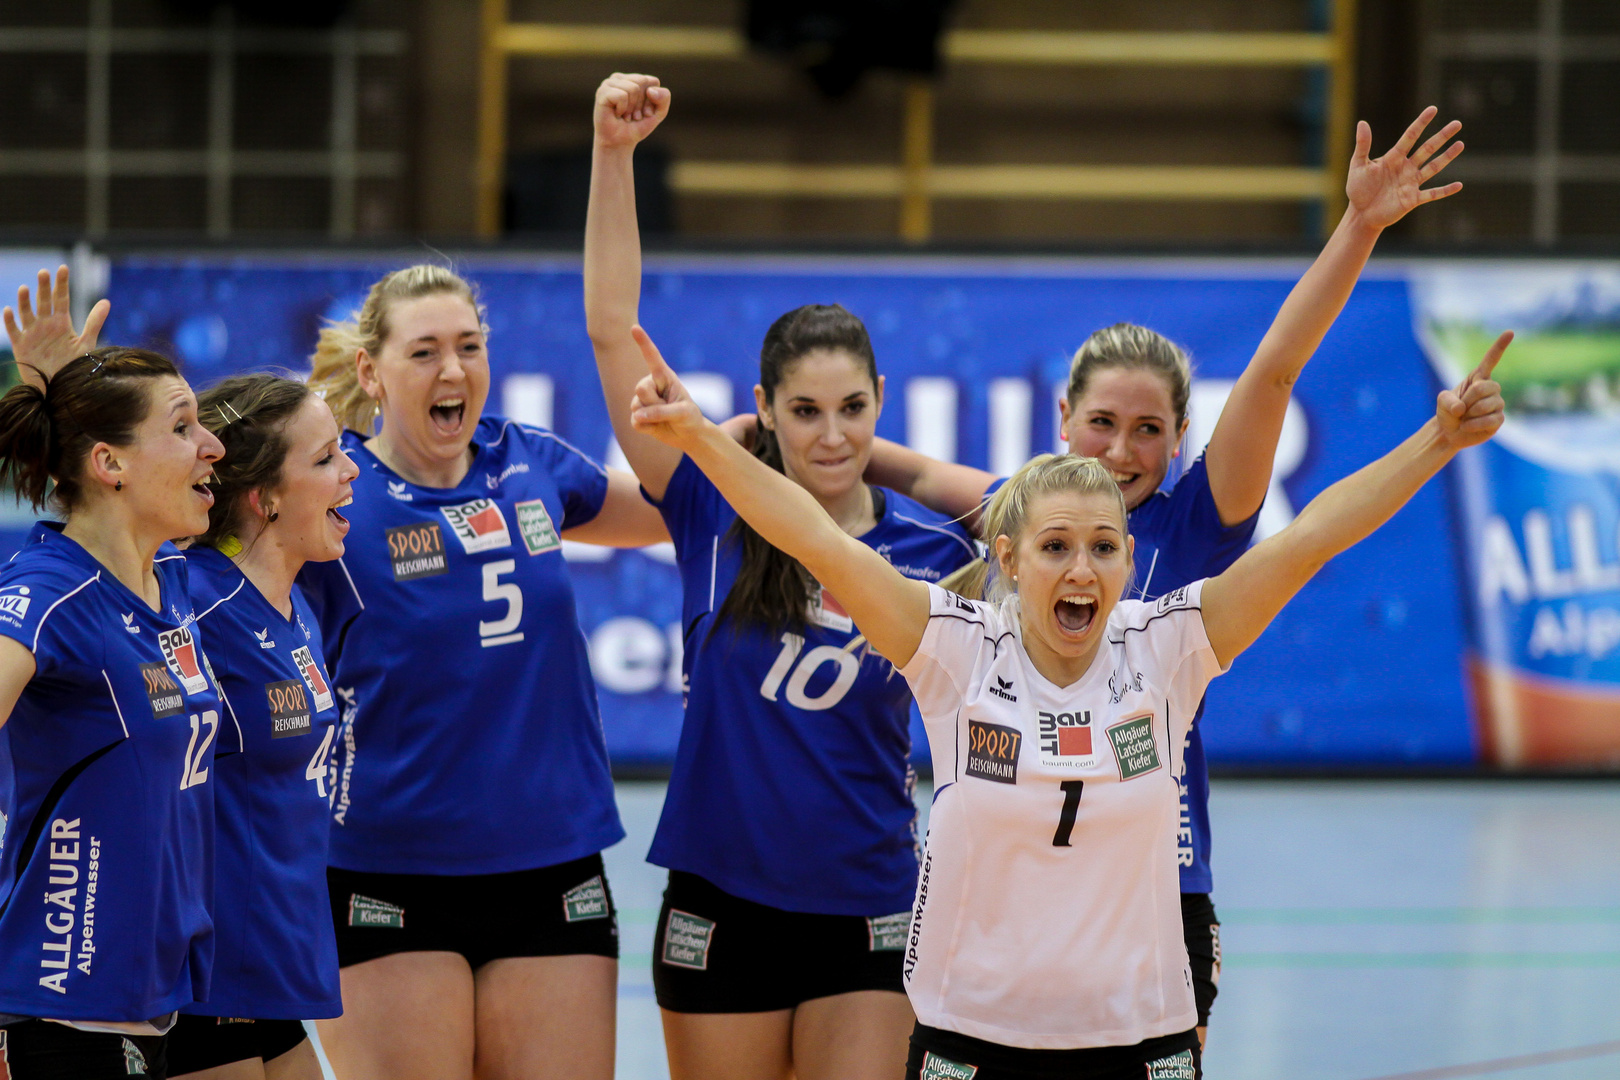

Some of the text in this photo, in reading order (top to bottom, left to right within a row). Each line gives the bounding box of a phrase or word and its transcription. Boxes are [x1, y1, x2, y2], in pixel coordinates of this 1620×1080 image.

[389, 525, 442, 558] SPORT
[396, 556, 444, 575] REISCHMANN
[1478, 505, 1620, 607] ALL
[0, 597, 22, 616] VL
[479, 559, 524, 638] 5
[143, 666, 178, 694] SPORT
[760, 632, 860, 711] 10
[268, 684, 307, 714] SPORT
[989, 686, 1017, 702] erima
[274, 714, 310, 732] REISCHMANN
[1114, 723, 1150, 745] Allgäuer
[180, 710, 219, 790] 12
[970, 725, 1021, 760] SPORT
[1117, 738, 1154, 760] Latschen
[305, 724, 335, 797] 4
[970, 758, 1014, 779] REISCHMANN
[1127, 754, 1152, 772] Kiefer
[1052, 780, 1084, 847] 1
[39, 817, 81, 995] ALLGÄUER
[77, 836, 101, 976] Alpenwasser
[361, 910, 391, 923] Kiefer
[904, 850, 933, 983] Alpenwasser
[672, 916, 708, 936] Allgäuer
[668, 930, 706, 950] Latschen
[671, 945, 696, 961] Kiefer
[928, 1057, 969, 1080] Allgäuer
[1153, 1066, 1193, 1080] Latschen
